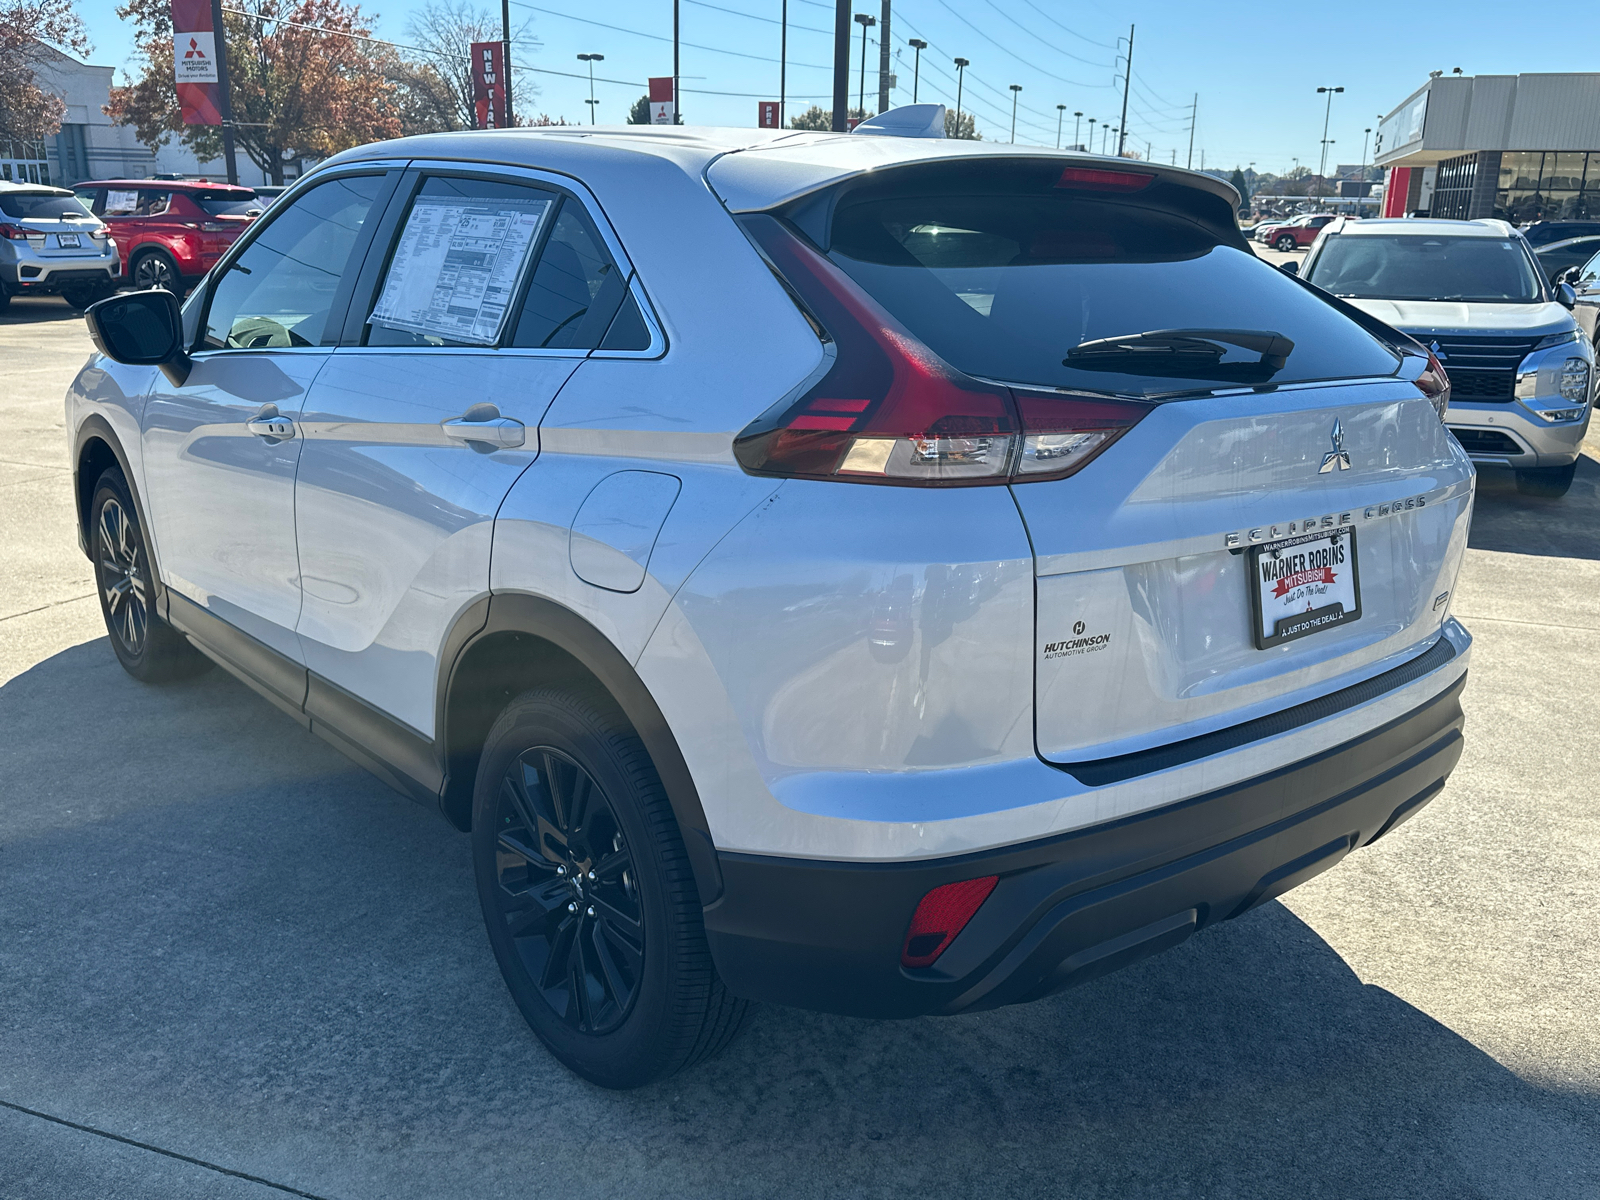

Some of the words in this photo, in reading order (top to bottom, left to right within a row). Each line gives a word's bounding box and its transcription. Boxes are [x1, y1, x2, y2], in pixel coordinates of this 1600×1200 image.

[483, 49, 496, 85] NEW
[1225, 513, 1351, 547] ECLIPSE
[1364, 495, 1426, 519] CROSS
[1262, 553, 1306, 582] WARNER
[1309, 544, 1345, 570] ROBINS
[1284, 568, 1326, 589] MITSUBISHI
[1284, 591, 1296, 606] Just
[1297, 588, 1305, 599] Do
[1305, 585, 1315, 596] The
[1287, 624, 1301, 635] JUST
[1301, 621, 1310, 631] DO
[1310, 617, 1321, 628] THE
[1321, 612, 1338, 624] DEAL!
[1044, 633, 1111, 653] HUTCHINSON
[1044, 647, 1085, 660] AUTOMOTIVE
[1086, 643, 1107, 653] GROUP
